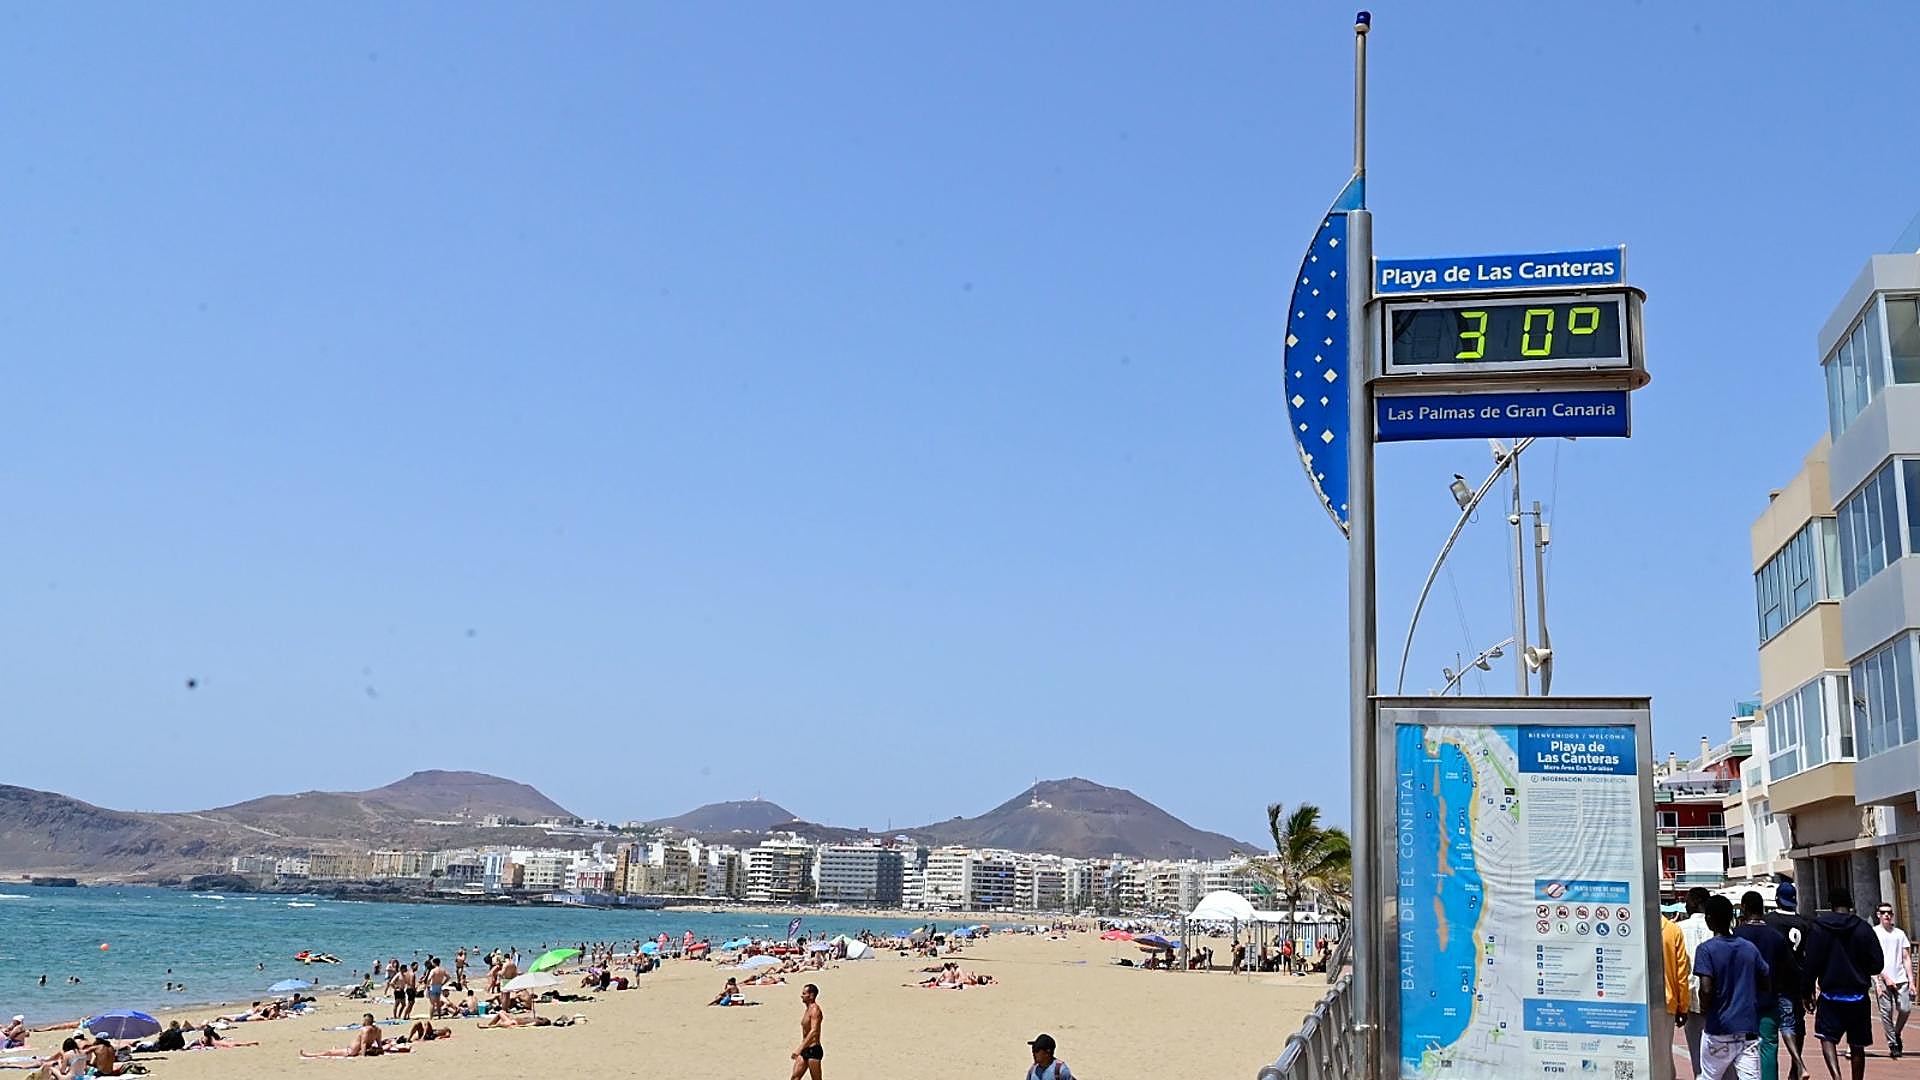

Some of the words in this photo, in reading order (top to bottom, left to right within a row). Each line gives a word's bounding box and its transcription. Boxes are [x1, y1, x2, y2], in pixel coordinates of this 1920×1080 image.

[1382, 268, 1437, 289] Playa
[1443, 266, 1471, 282] de
[1477, 264, 1512, 281] Las
[1518, 260, 1615, 279] Canteras
[1388, 406, 1414, 421] Las
[1418, 405, 1475, 421] Palmas
[1480, 405, 1500, 419] de
[1505, 404, 1547, 419] Gran
[1552, 402, 1616, 418] Canaria
[1551, 741, 1586, 754] Playa
[1588, 741, 1605, 753] de
[1537, 752, 1559, 763] Las
[1561, 752, 1620, 765] Canteras
[1401, 769, 1414, 858] CONFITAL
[1401, 868, 1415, 887] EL
[1401, 898, 1415, 921] DE
[1789, 927, 1801, 951] 9
